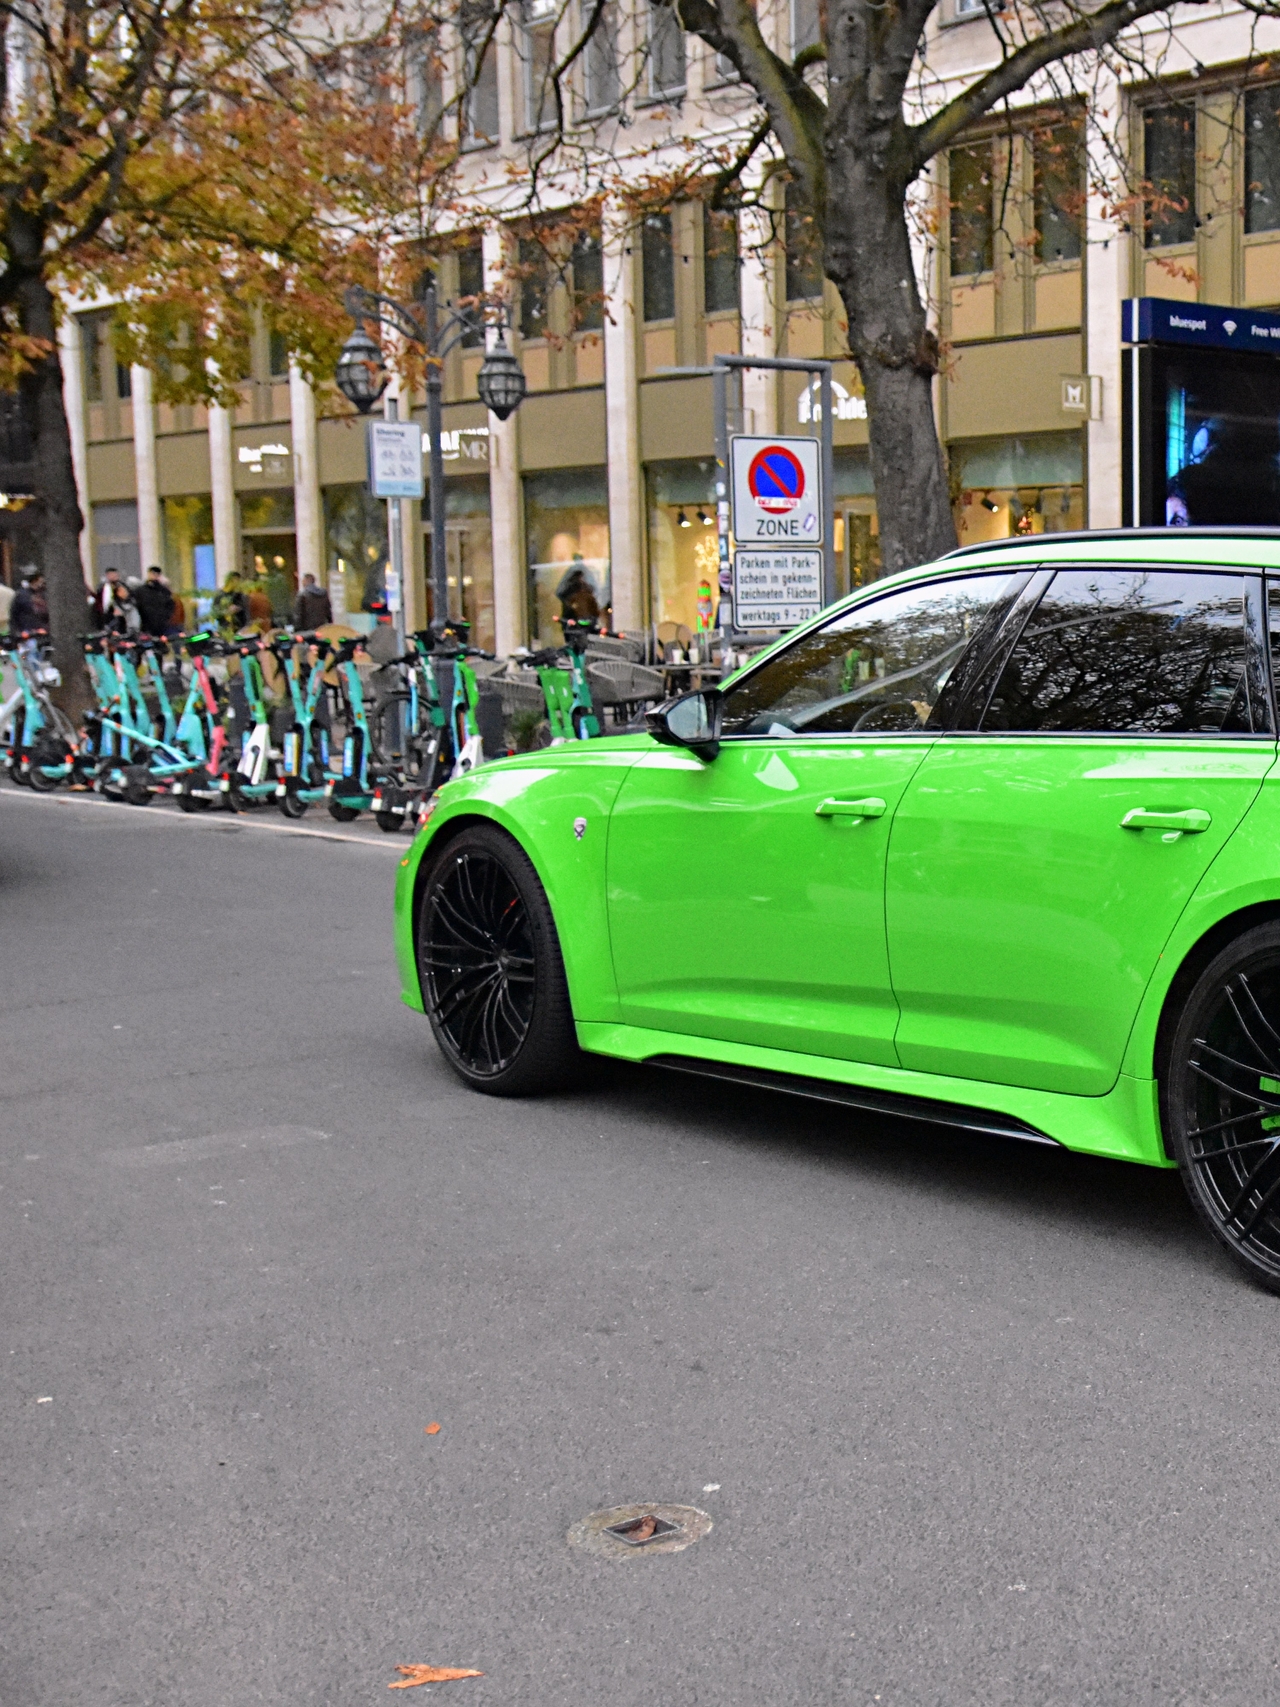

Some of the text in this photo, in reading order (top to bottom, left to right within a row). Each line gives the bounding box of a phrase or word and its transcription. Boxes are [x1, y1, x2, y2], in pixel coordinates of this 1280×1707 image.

[1170, 315, 1206, 331] bluespot
[1251, 324, 1269, 337] Free
[757, 520, 799, 535] ZONE
[741, 556, 815, 568] Parken mit Park-
[740, 572, 816, 586] schein in gekenn-
[740, 587, 817, 599] zeichneten Flächen
[741, 610, 780, 623] werktags
[784, 609, 789, 619] 9
[799, 608, 809, 620] 22
